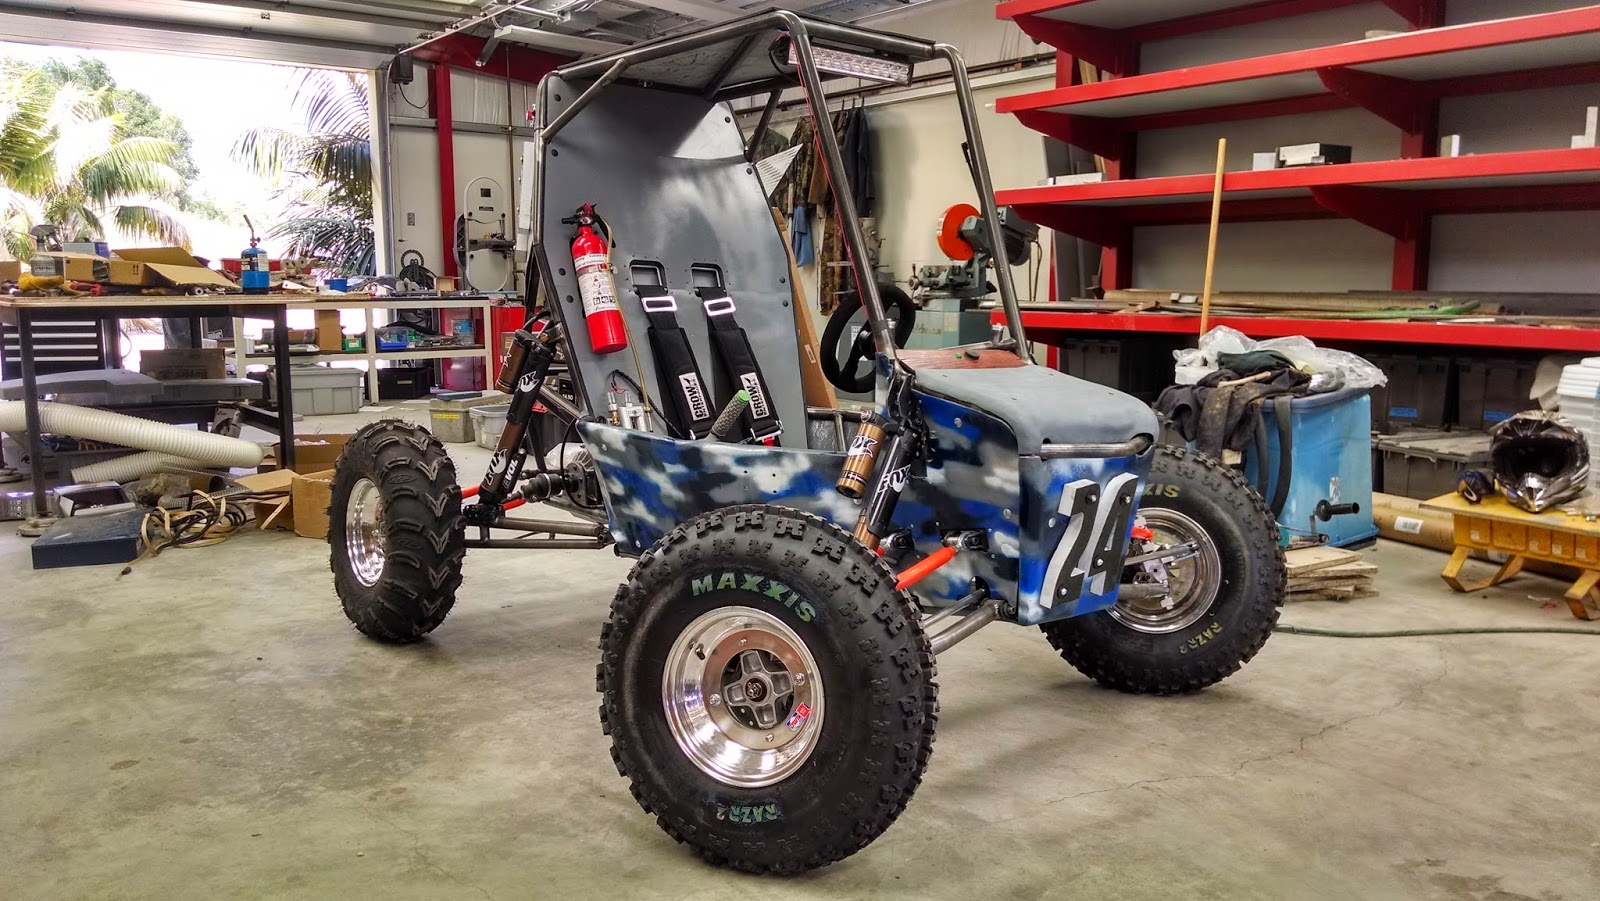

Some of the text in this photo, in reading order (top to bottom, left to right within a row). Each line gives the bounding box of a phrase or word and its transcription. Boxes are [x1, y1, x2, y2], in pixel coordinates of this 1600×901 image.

[685, 386, 704, 418] CROW
[746, 385, 764, 417] CROW
[877, 464, 911, 493] FOX
[1143, 483, 1180, 498] XIS
[1040, 472, 1139, 609] 24
[691, 571, 816, 622] MAXXIS
[1186, 621, 1222, 649] RAZR
[728, 803, 778, 823] RAZR
